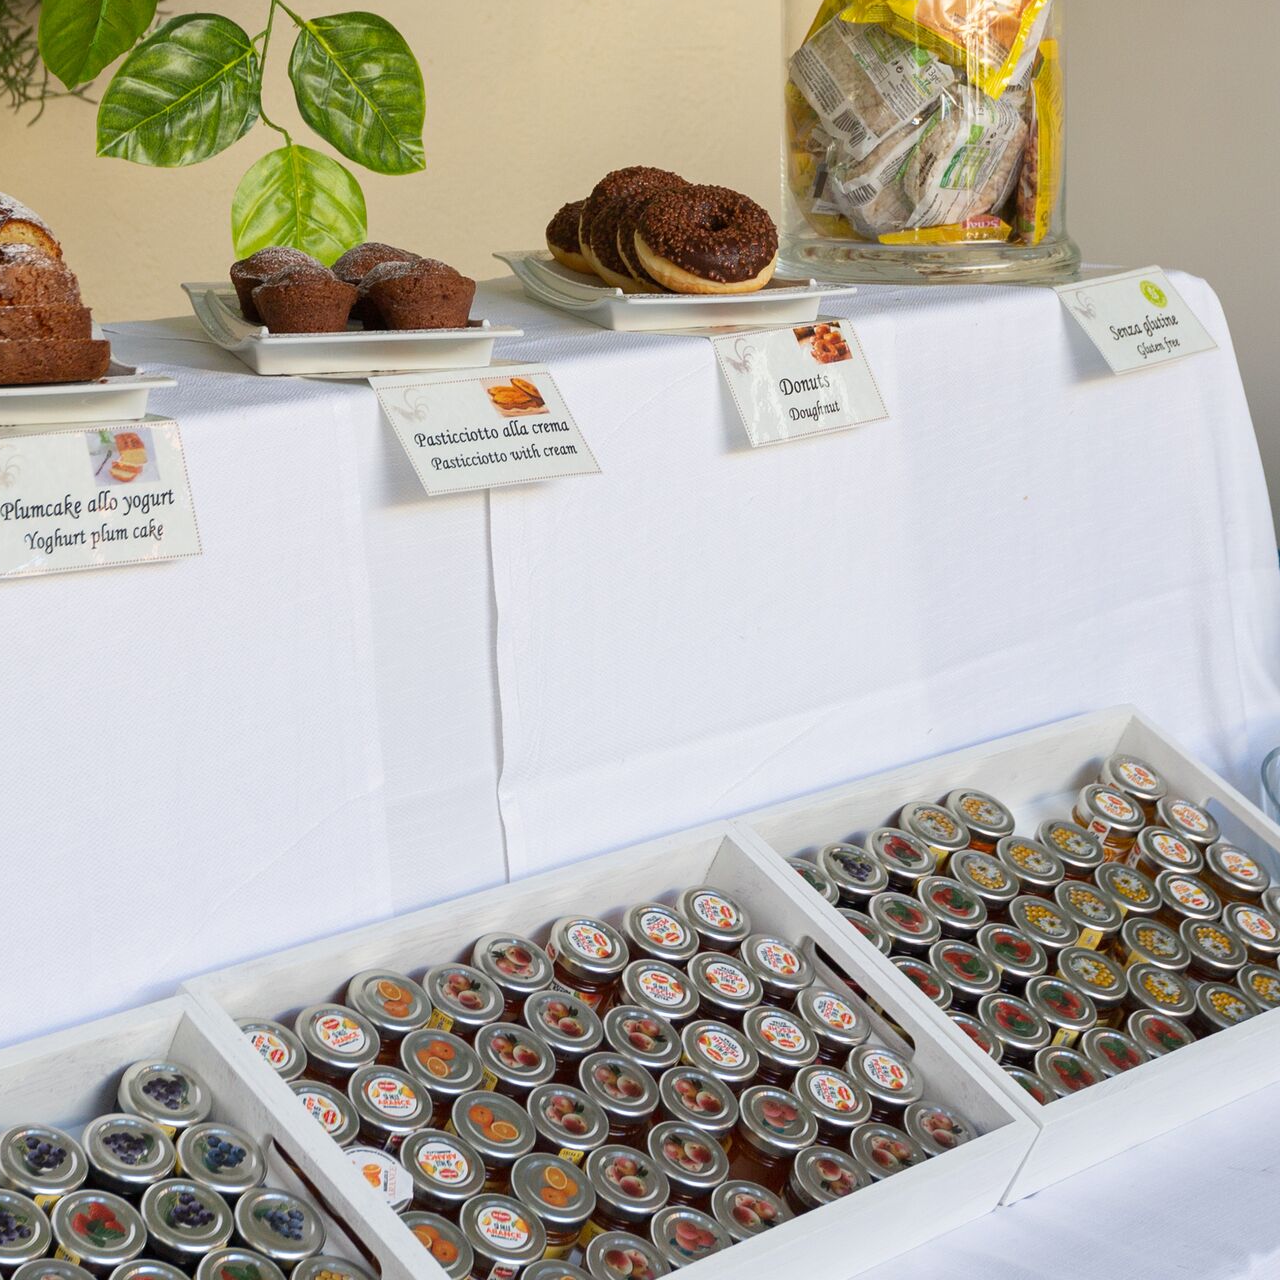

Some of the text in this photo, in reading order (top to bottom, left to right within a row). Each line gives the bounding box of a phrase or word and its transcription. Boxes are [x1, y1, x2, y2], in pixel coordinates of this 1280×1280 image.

[1109, 314, 1179, 341] Senza glutine
[1136, 336, 1180, 359] Gluten free
[779, 374, 830, 396] Donuts
[788, 400, 841, 421] Doughnut
[414, 420, 570, 448] Pasticciotto alla crema
[431, 443, 578, 470] Pasticciotto with cream
[0, 488, 175, 521] Plumcake allo yogurt
[24, 518, 164, 554] Yoghurt plum cake
